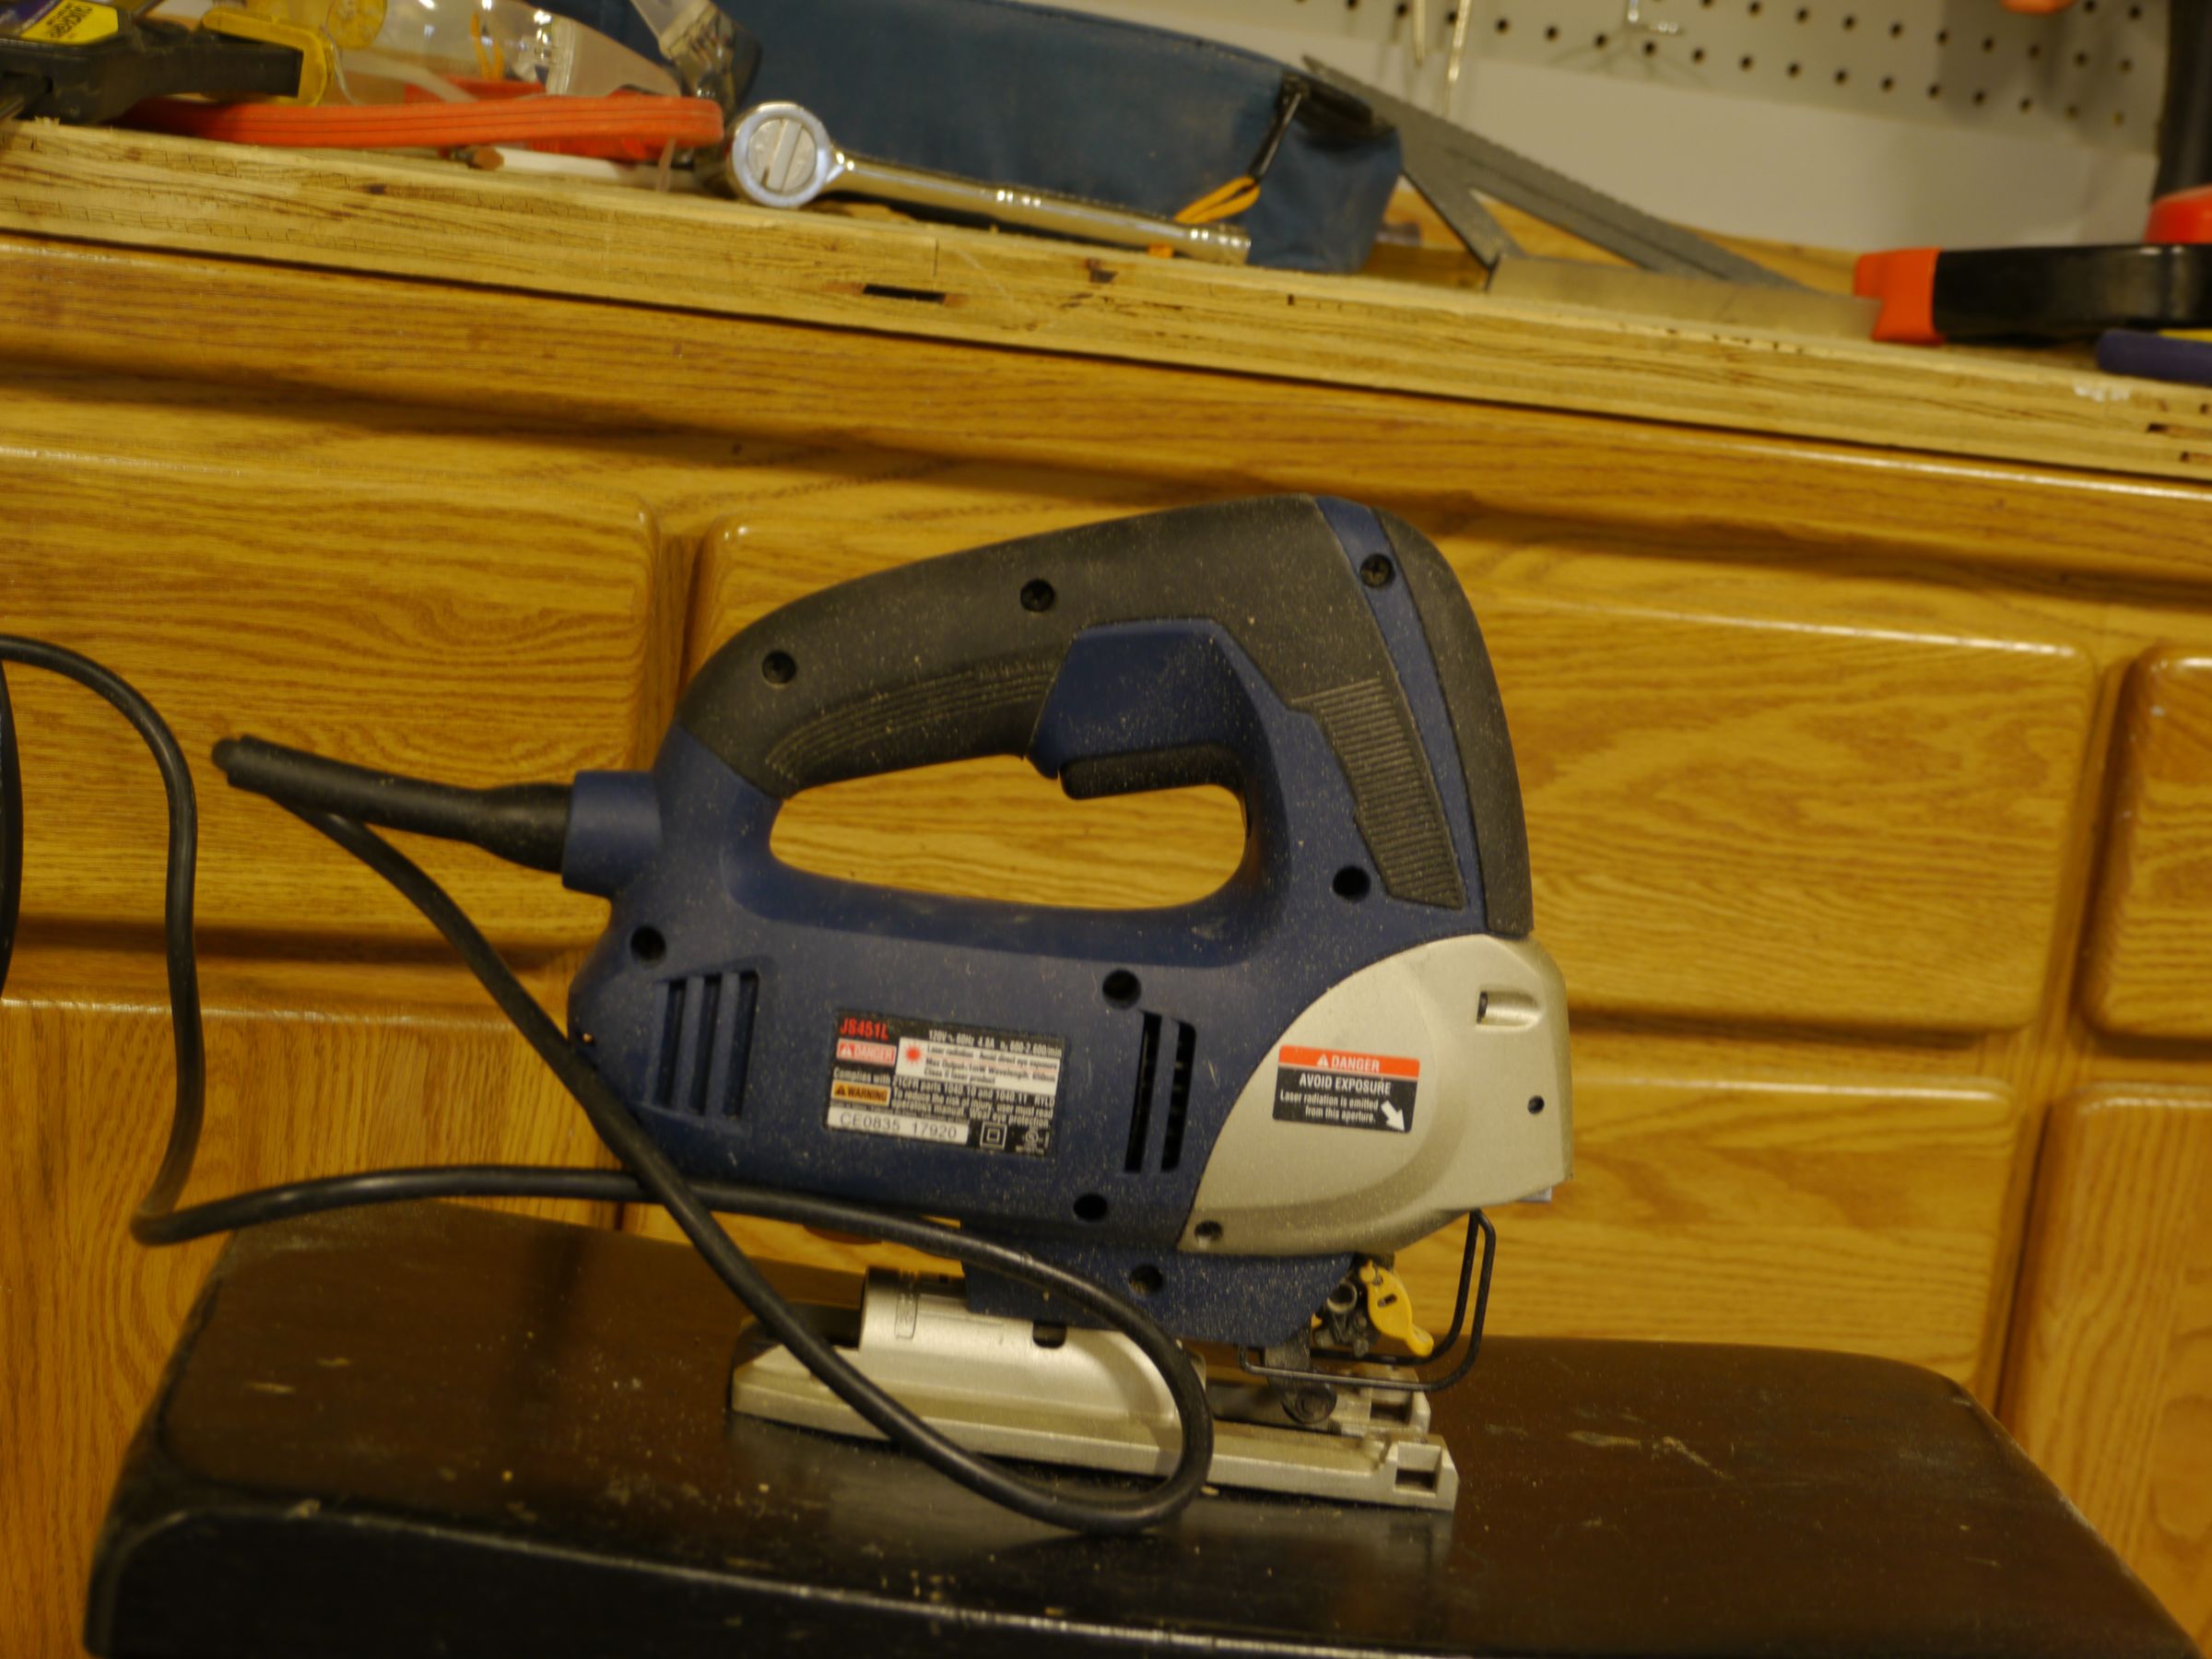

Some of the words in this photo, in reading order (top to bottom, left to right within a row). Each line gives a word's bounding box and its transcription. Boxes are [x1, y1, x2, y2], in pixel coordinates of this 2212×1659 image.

[841, 1018, 890, 1040] JS451L
[928, 1030, 947, 1041] 120V
[855, 1044, 893, 1059] DANGER
[1331, 1055, 1380, 1071] DANGER
[1300, 1073, 1333, 1088] AVOID
[1335, 1077, 1392, 1095] EXPOSURE
[847, 1087, 887, 1100] WARNING
[932, 1093, 944, 1103] the
[946, 1095, 959, 1105] risk
[961, 1097, 970, 1107] of
[997, 1103, 1013, 1113] user
[1016, 1105, 1034, 1115] must
[1036, 1108, 1053, 1118] read
[1280, 1089, 1301, 1101] Laser
[1304, 1093, 1338, 1105] radiation
[1340, 1097, 1347, 1107] is
[1350, 1098, 1378, 1110] emitted
[841, 1112, 900, 1130] CE0835
[912, 1123, 957, 1136] 17920
[993, 1113, 1006, 1124] eye
[1305, 1107, 1324, 1118] from
[1325, 1109, 1339, 1119] this
[1341, 1111, 1376, 1124] aperture.
